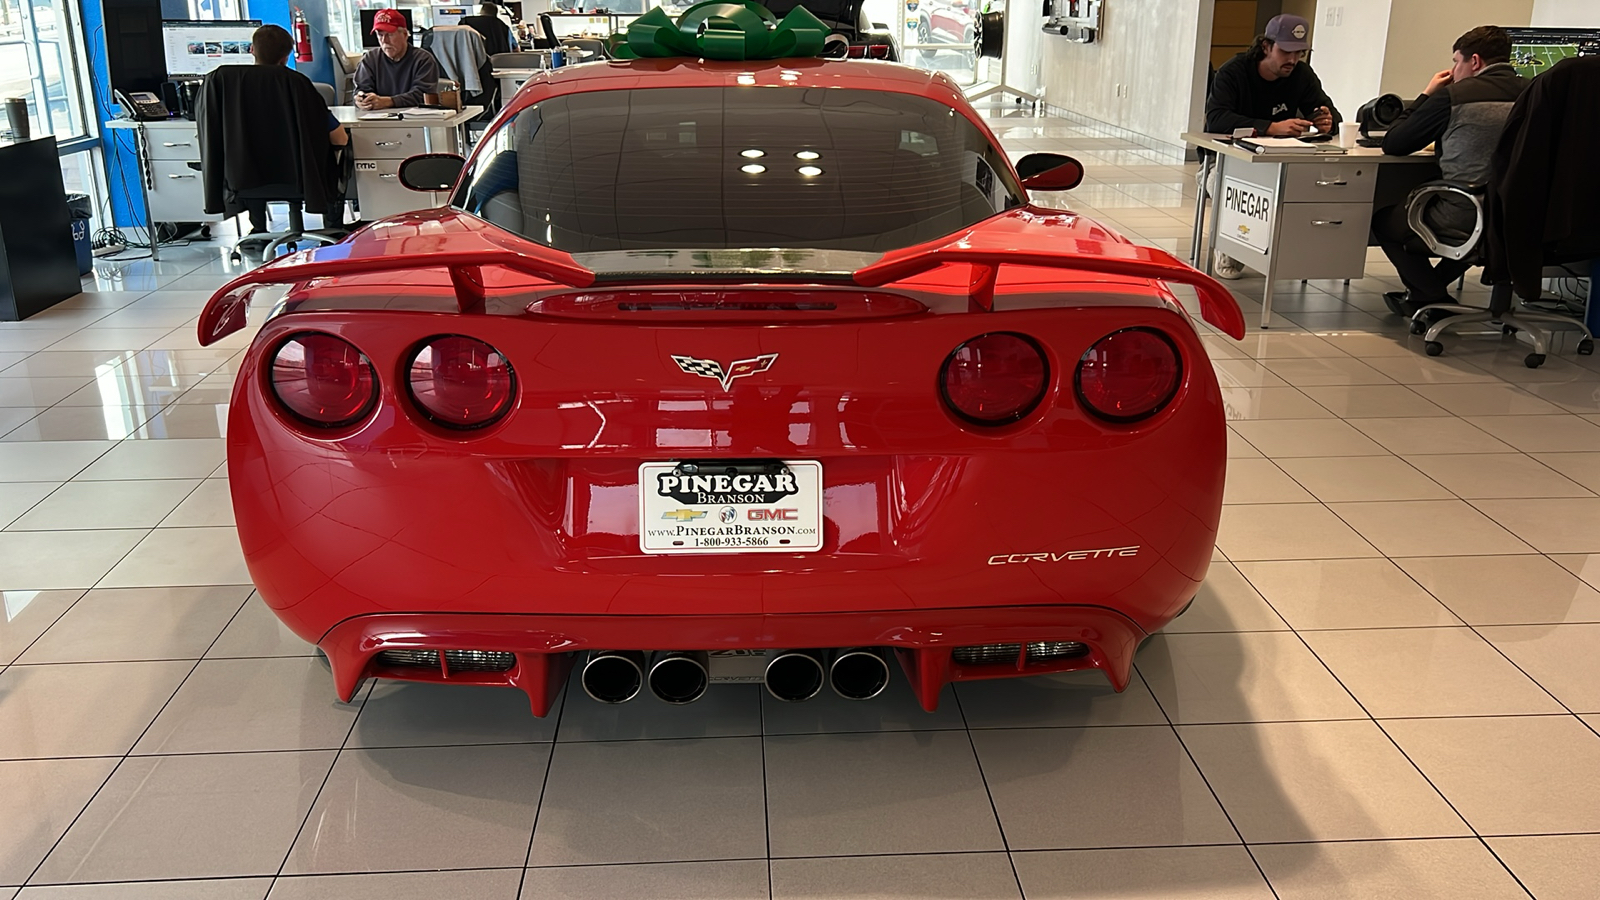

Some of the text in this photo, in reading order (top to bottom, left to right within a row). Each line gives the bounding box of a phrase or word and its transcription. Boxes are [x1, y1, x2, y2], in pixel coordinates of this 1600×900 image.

[1225, 186, 1270, 222] PINEGAR
[660, 474, 796, 493] PINEGAR
[697, 492, 765, 504] BRANSON
[747, 508, 799, 521] GMC
[695, 537, 769, 547] 1-800-933-5866
[987, 545, 1141, 566] CORVETTE
